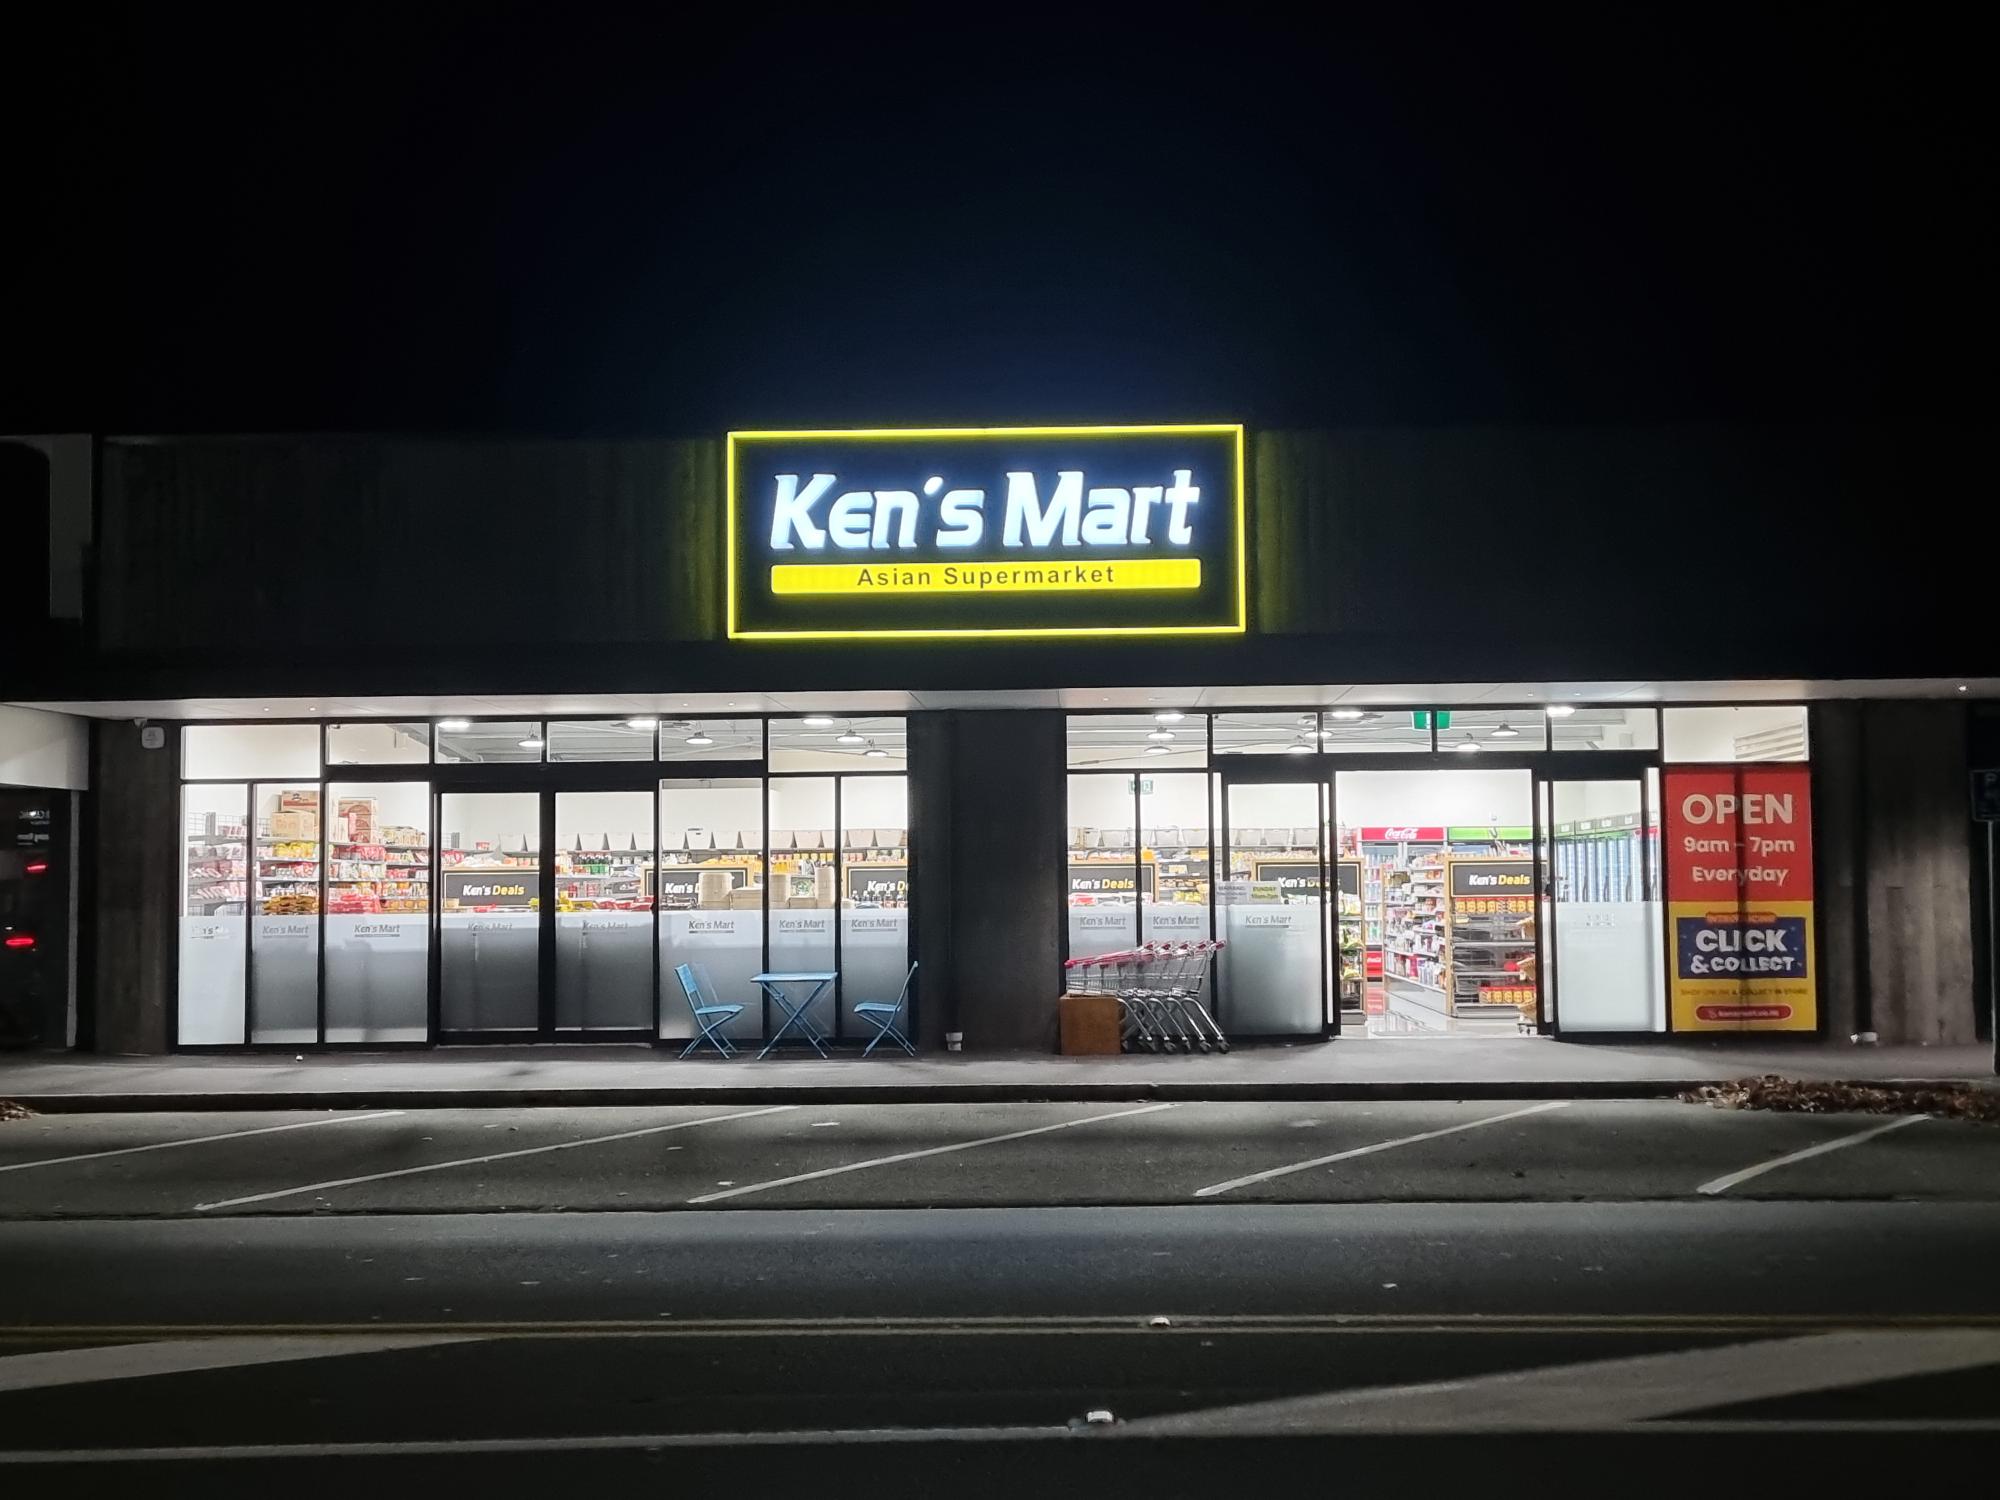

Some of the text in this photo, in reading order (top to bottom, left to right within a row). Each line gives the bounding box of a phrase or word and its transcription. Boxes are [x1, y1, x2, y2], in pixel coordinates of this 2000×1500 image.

[770, 469, 1200, 550] Ken's Mart
[857, 565, 1114, 588] Asian Supermarket
[1682, 793, 1793, 824] OPEN
[1683, 836, 1730, 853] 9am
[1749, 836, 1796, 857] 7pm
[1498, 874, 1531, 885] Deals
[1692, 866, 1789, 887] Everyday
[463, 884, 525, 896] Ken's Deals
[665, 882, 694, 894] Ken's
[867, 881, 896, 891] Ken's
[1072, 879, 1135, 890] Ken's Deals
[688, 920, 735, 930] Ken's Mart
[803, 919, 825, 929] Mart
[876, 918, 897, 928] Mart
[1104, 916, 1126, 926] Mart
[1177, 915, 1200, 925] Mart
[1270, 915, 1292, 924] Mart
[379, 924, 400, 933] Mart
[1695, 929, 1788, 952] CLICK
